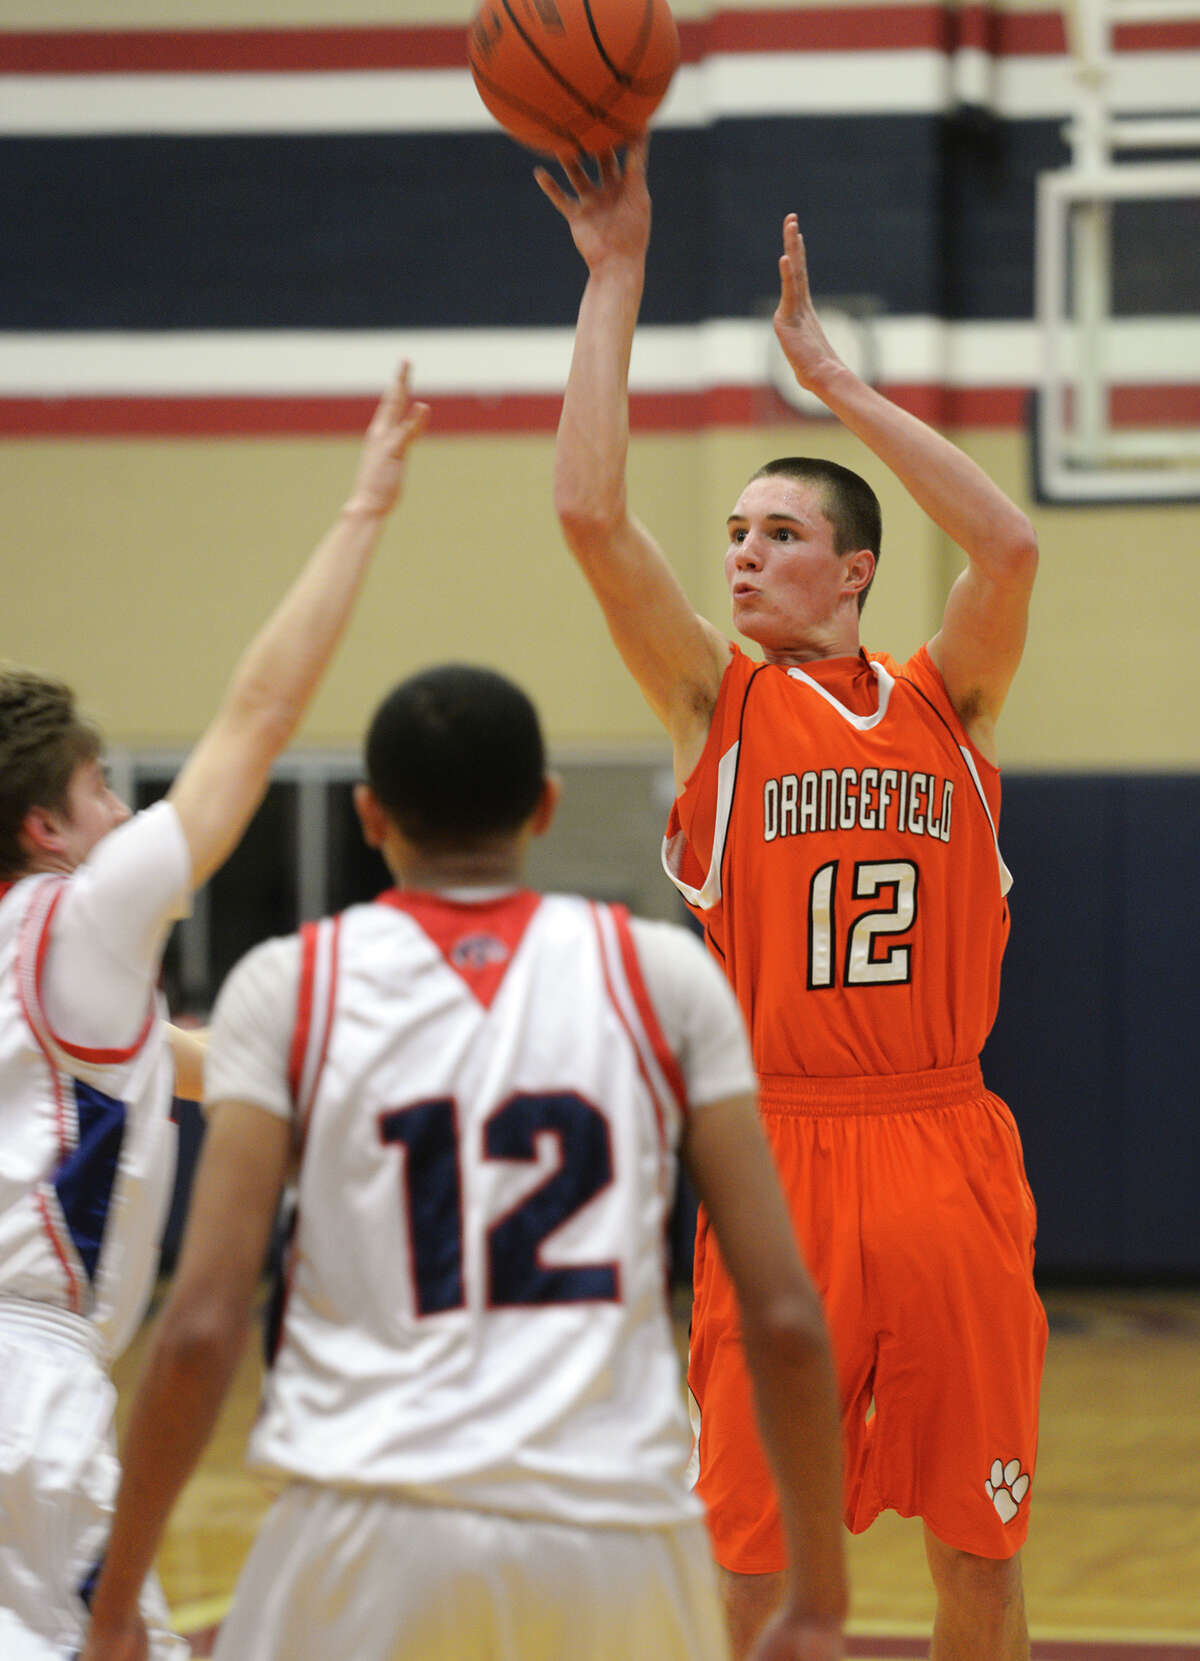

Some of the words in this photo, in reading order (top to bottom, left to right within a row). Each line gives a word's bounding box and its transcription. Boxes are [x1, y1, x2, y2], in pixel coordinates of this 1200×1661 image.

[763, 768, 954, 843] ORANGEFIELD
[807, 859, 919, 991] 12
[377, 1090, 624, 1318] 12
